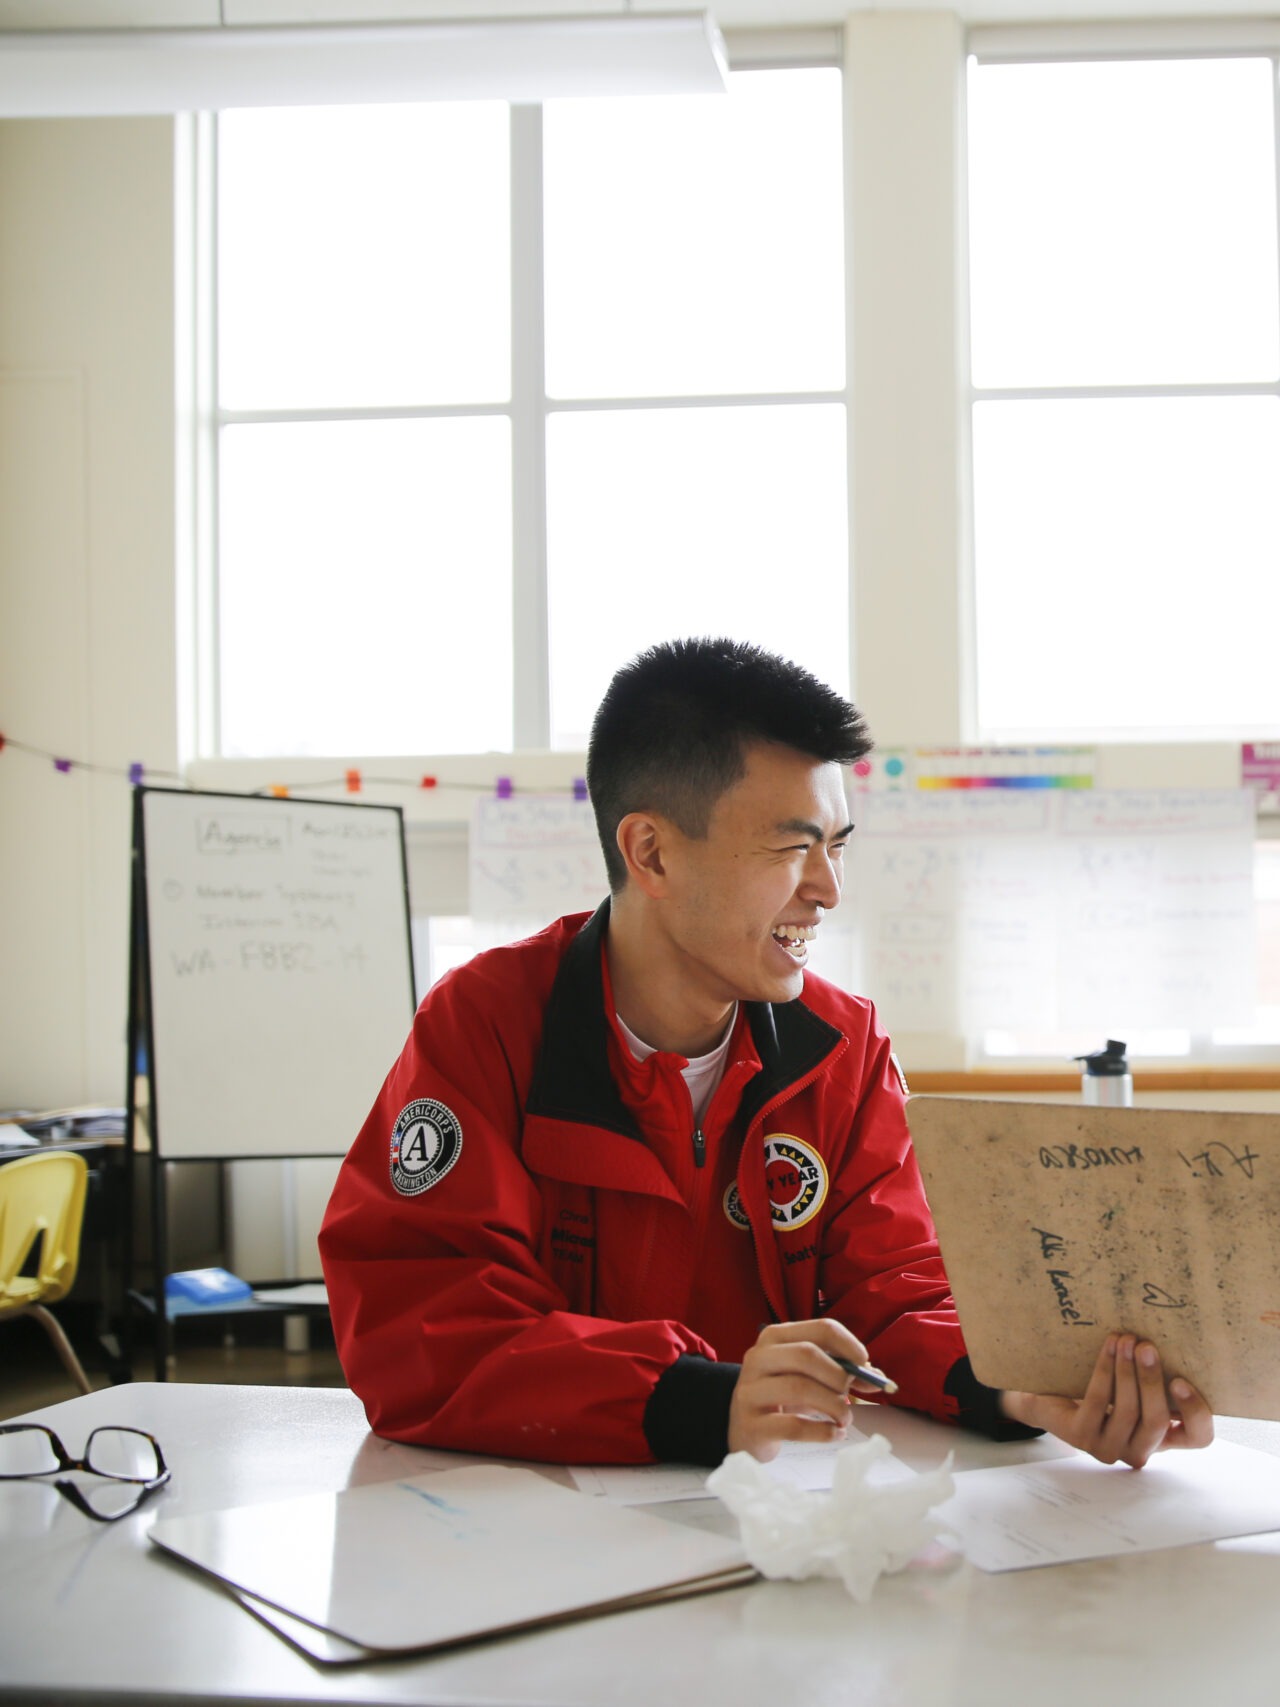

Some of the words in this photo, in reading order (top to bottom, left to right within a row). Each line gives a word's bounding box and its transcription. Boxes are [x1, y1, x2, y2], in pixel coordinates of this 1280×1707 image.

[399, 1105, 454, 1134] AMERICORPS
[403, 1125, 430, 1162] A
[394, 1167, 438, 1189] WASHINGTON
[777, 1166, 820, 1189] YEAR
